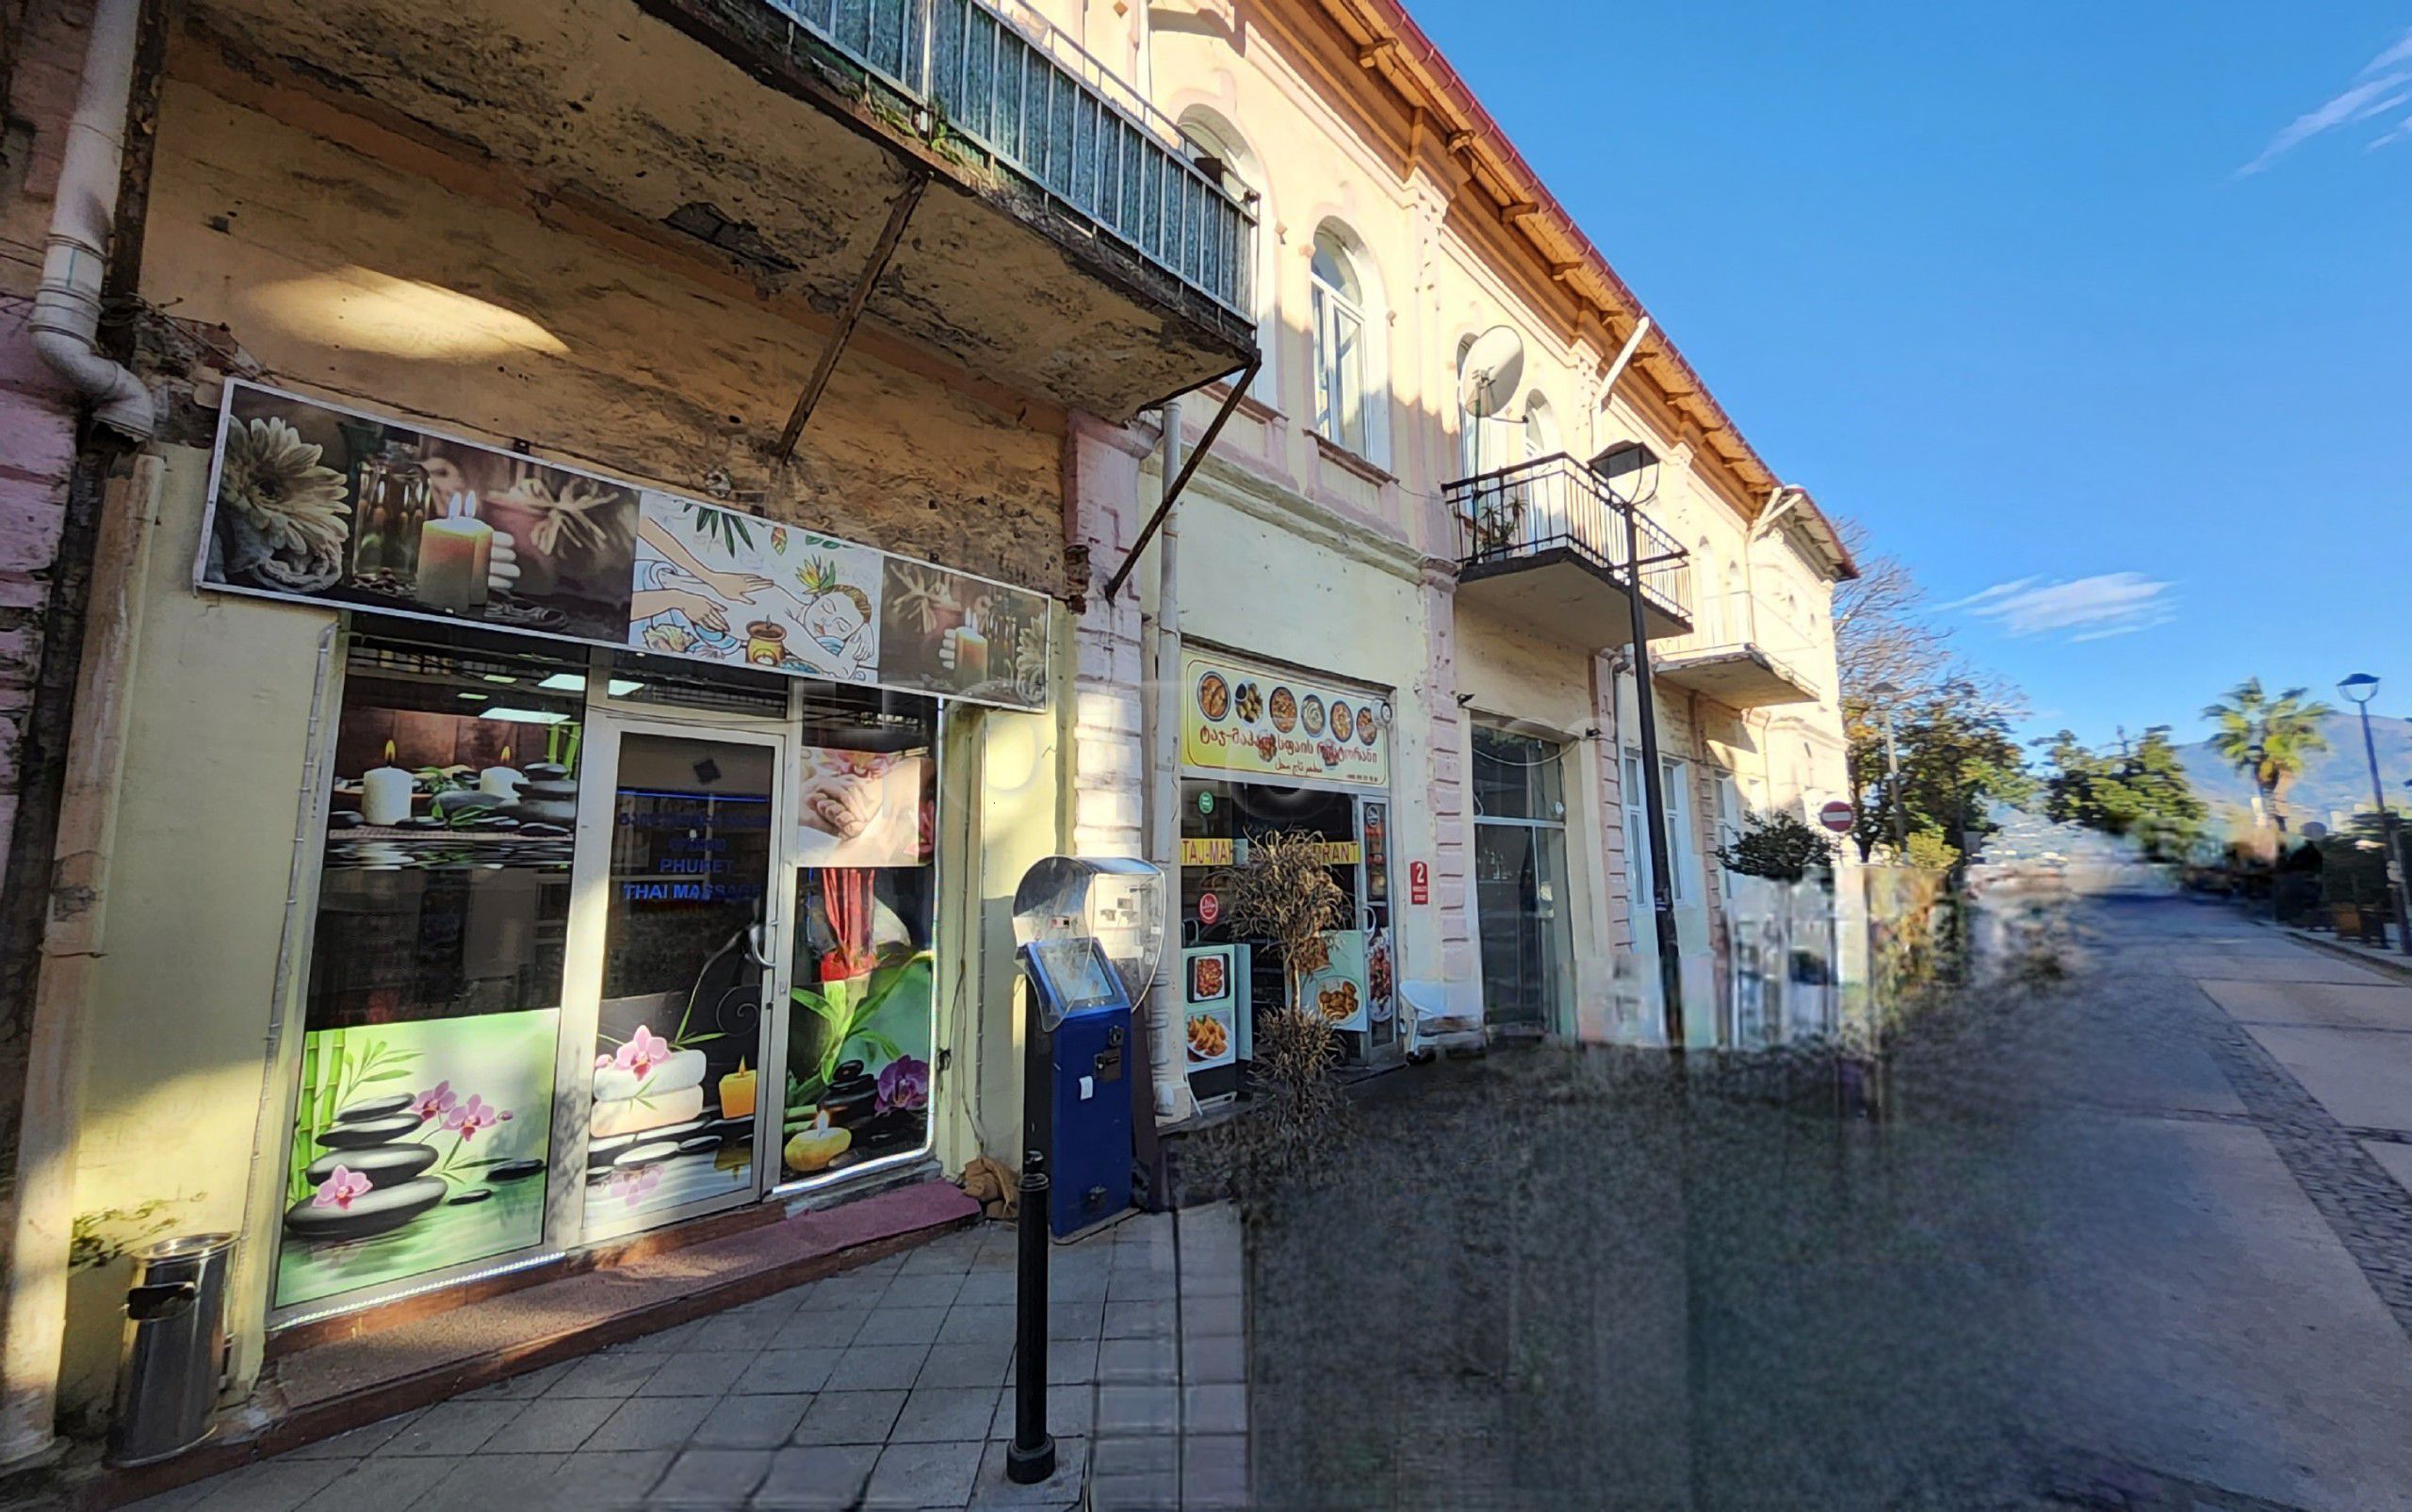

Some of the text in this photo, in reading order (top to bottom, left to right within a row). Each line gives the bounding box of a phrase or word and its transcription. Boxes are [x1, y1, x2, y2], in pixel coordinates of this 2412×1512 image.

[1182, 840, 1234, 865] TAJ-MAH
[660, 858, 735, 873] PHUKET
[1416, 863, 1426, 884] 2
[623, 884, 762, 901] THAI MASSAGE
